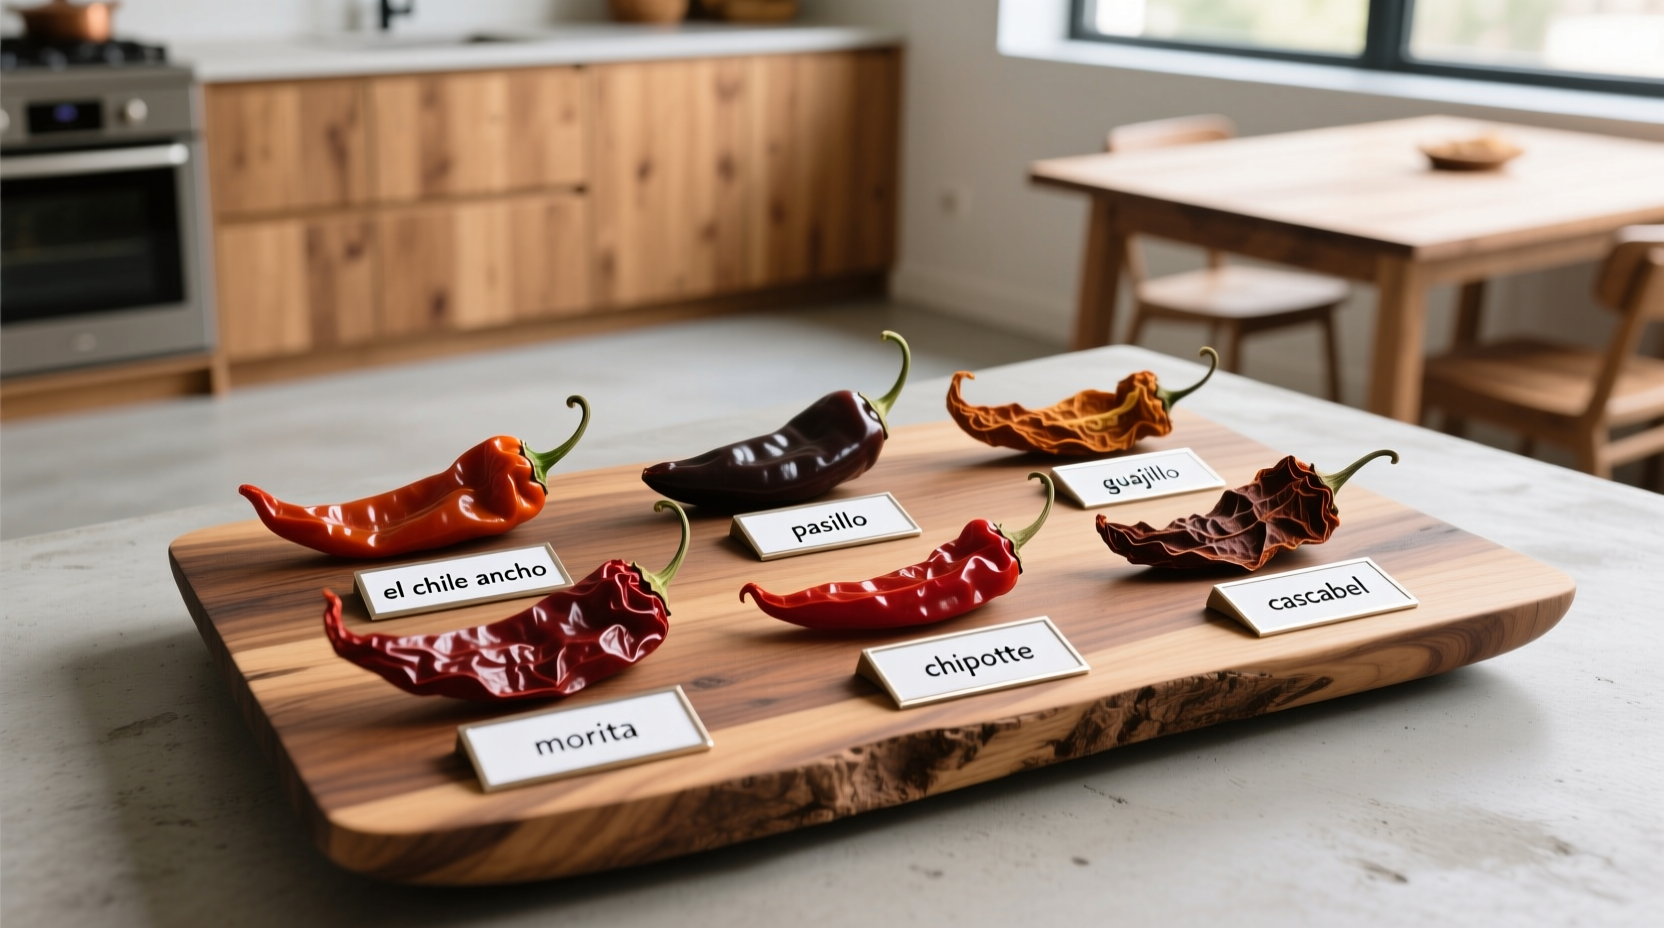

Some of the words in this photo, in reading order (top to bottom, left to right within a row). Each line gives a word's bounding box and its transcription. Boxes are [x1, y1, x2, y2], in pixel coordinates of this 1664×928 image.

[1103, 465, 1180, 495] guajillo
[791, 511, 868, 543] pasillo
[383, 580, 405, 600] el
[412, 573, 469, 596] chile
[475, 562, 547, 586] ancho
[1268, 575, 1371, 611] cascabel
[925, 645, 1035, 677] chipotte
[535, 723, 638, 756] morita
